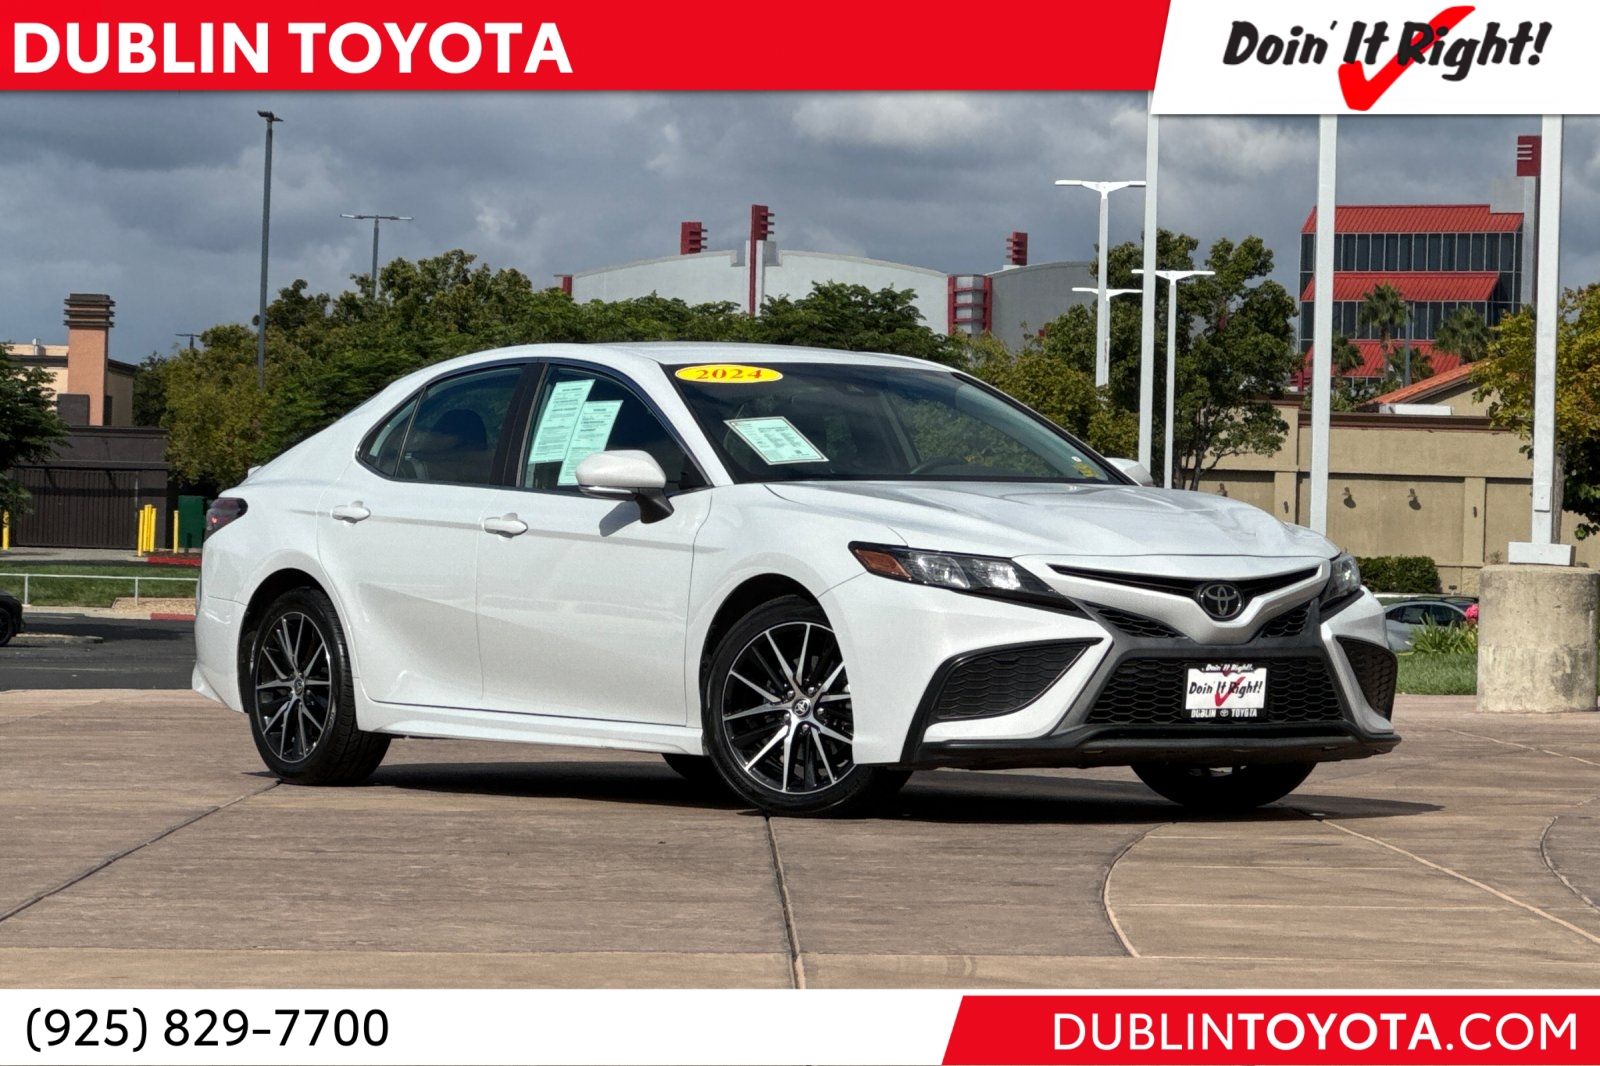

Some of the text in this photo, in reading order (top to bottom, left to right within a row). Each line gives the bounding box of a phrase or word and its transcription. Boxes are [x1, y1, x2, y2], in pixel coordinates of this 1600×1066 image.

[696, 368, 763, 380] 2024
[1189, 680, 1263, 698] Doin' It Right!
[1190, 708, 1258, 718] DUBLIN TOYOTA
